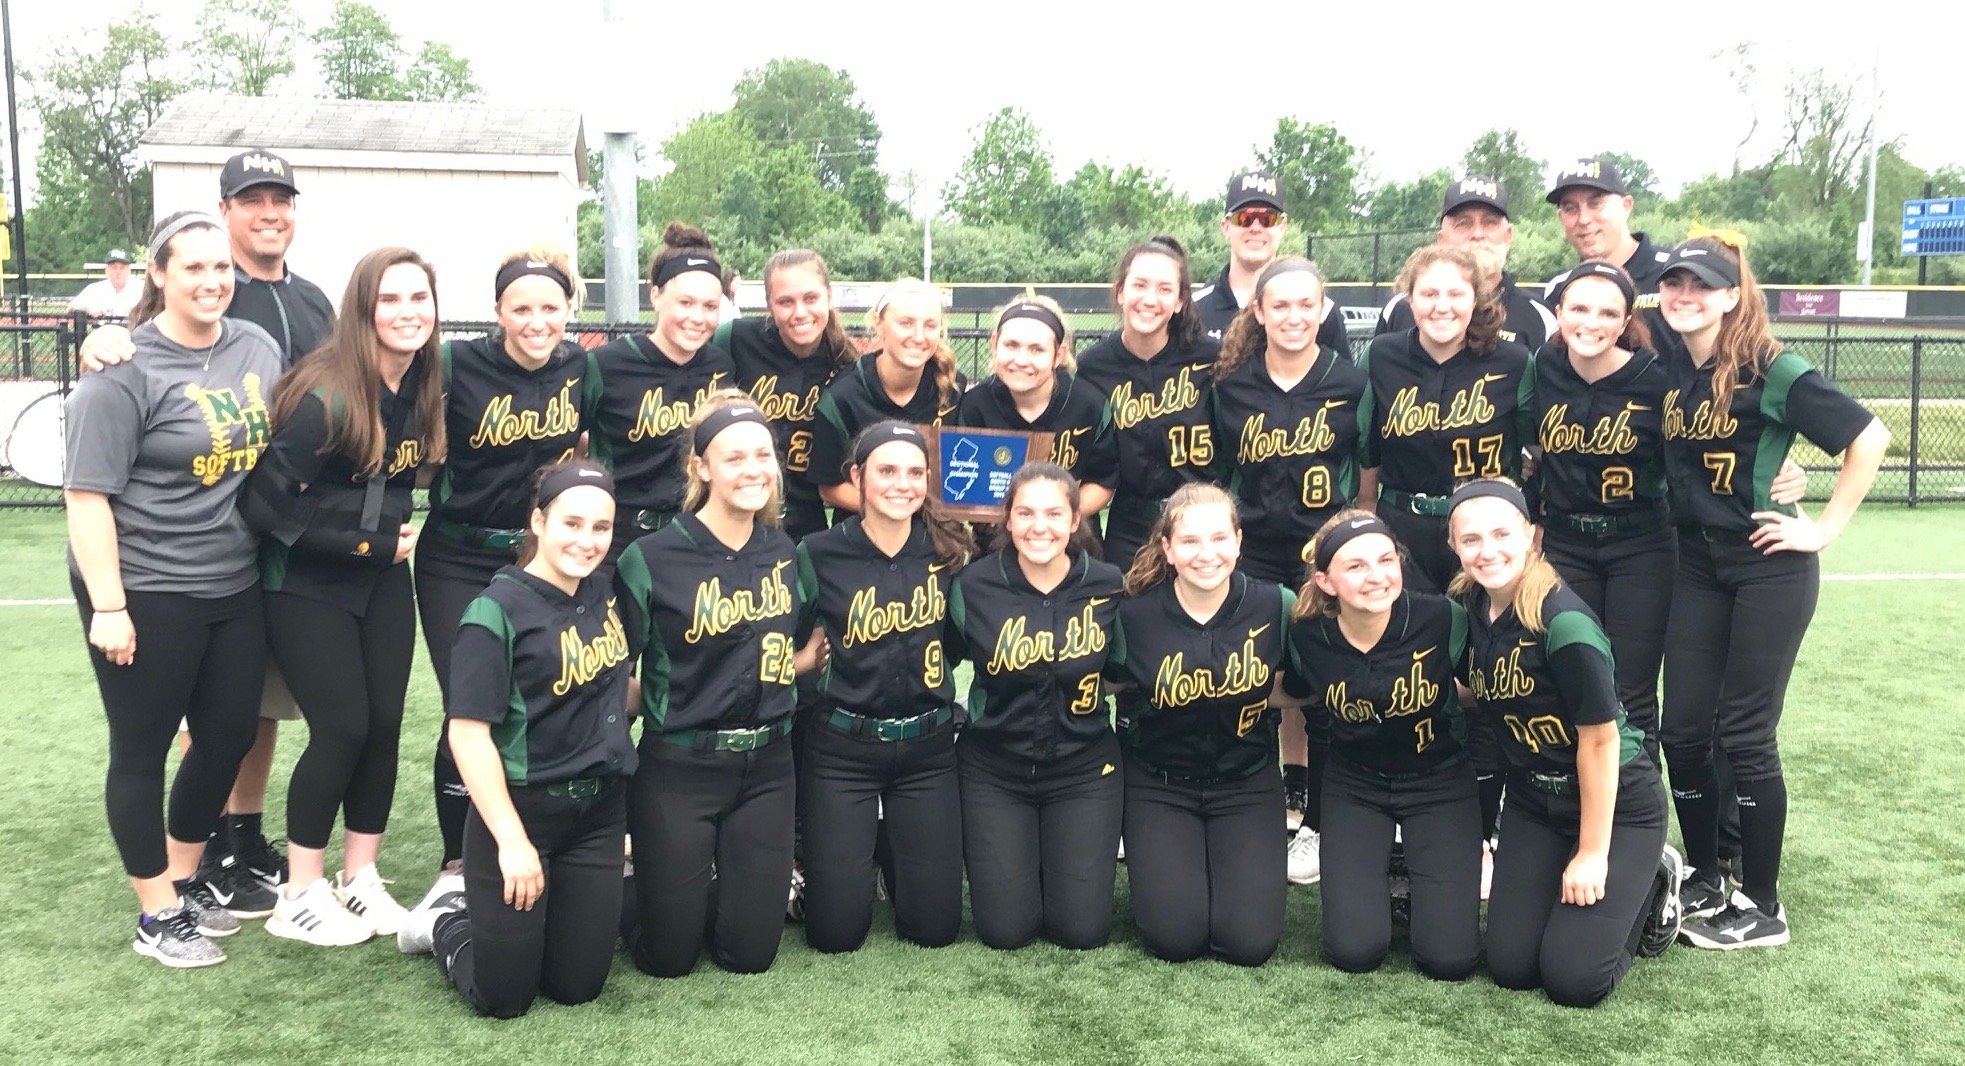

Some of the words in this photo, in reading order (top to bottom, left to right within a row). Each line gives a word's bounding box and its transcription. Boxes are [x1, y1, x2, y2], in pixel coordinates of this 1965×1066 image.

[469, 387, 580, 449] North
[751, 375, 820, 422] Nort
[1110, 366, 1200, 430] North
[1381, 378, 1495, 439] North
[1168, 424, 1214, 467] 15
[1237, 407, 1336, 465] North
[1539, 408, 1639, 454] North
[192, 448, 258, 477] SOFTB
[1452, 433, 1504, 477] 17
[1703, 452, 1736, 495] 7
[1302, 465, 1331, 508] 8
[1601, 466, 1634, 504] 2
[685, 567, 792, 644] North
[842, 574, 946, 649] North
[987, 604, 1106, 676] North
[924, 640, 944, 689] 9
[1151, 638, 1269, 710] North
[1071, 672, 1100, 715] 3
[1325, 661, 1439, 724] North
[1237, 698, 1268, 738] 5
[1415, 717, 1435, 754] 1
[1503, 714, 1572, 754] 10
